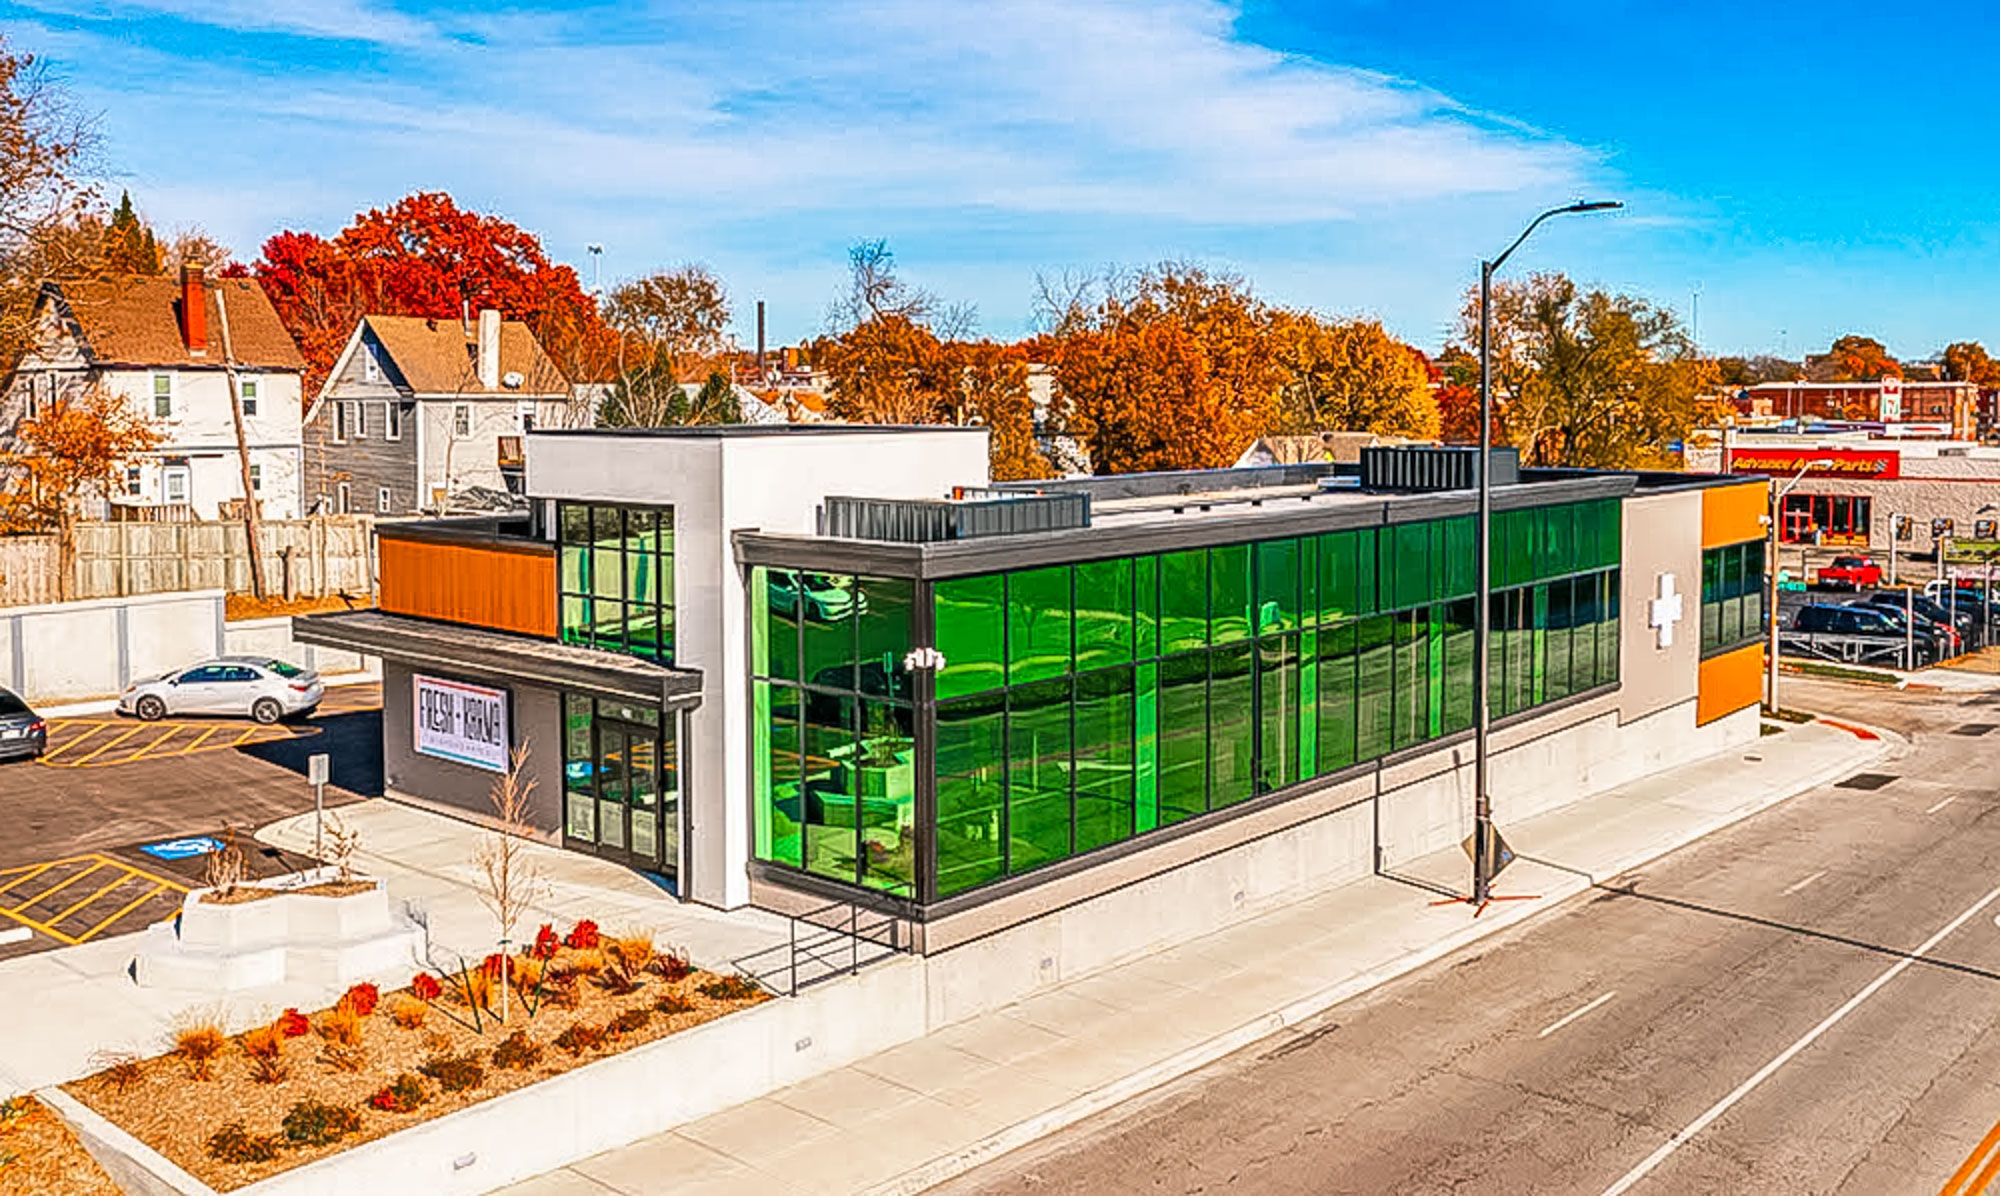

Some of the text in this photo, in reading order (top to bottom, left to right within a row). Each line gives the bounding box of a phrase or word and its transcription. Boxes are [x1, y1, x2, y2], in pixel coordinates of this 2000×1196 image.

[1733, 457, 1791, 470] Advance
[1832, 458, 1874, 472] Parts
[420, 688, 454, 734] FRESH
